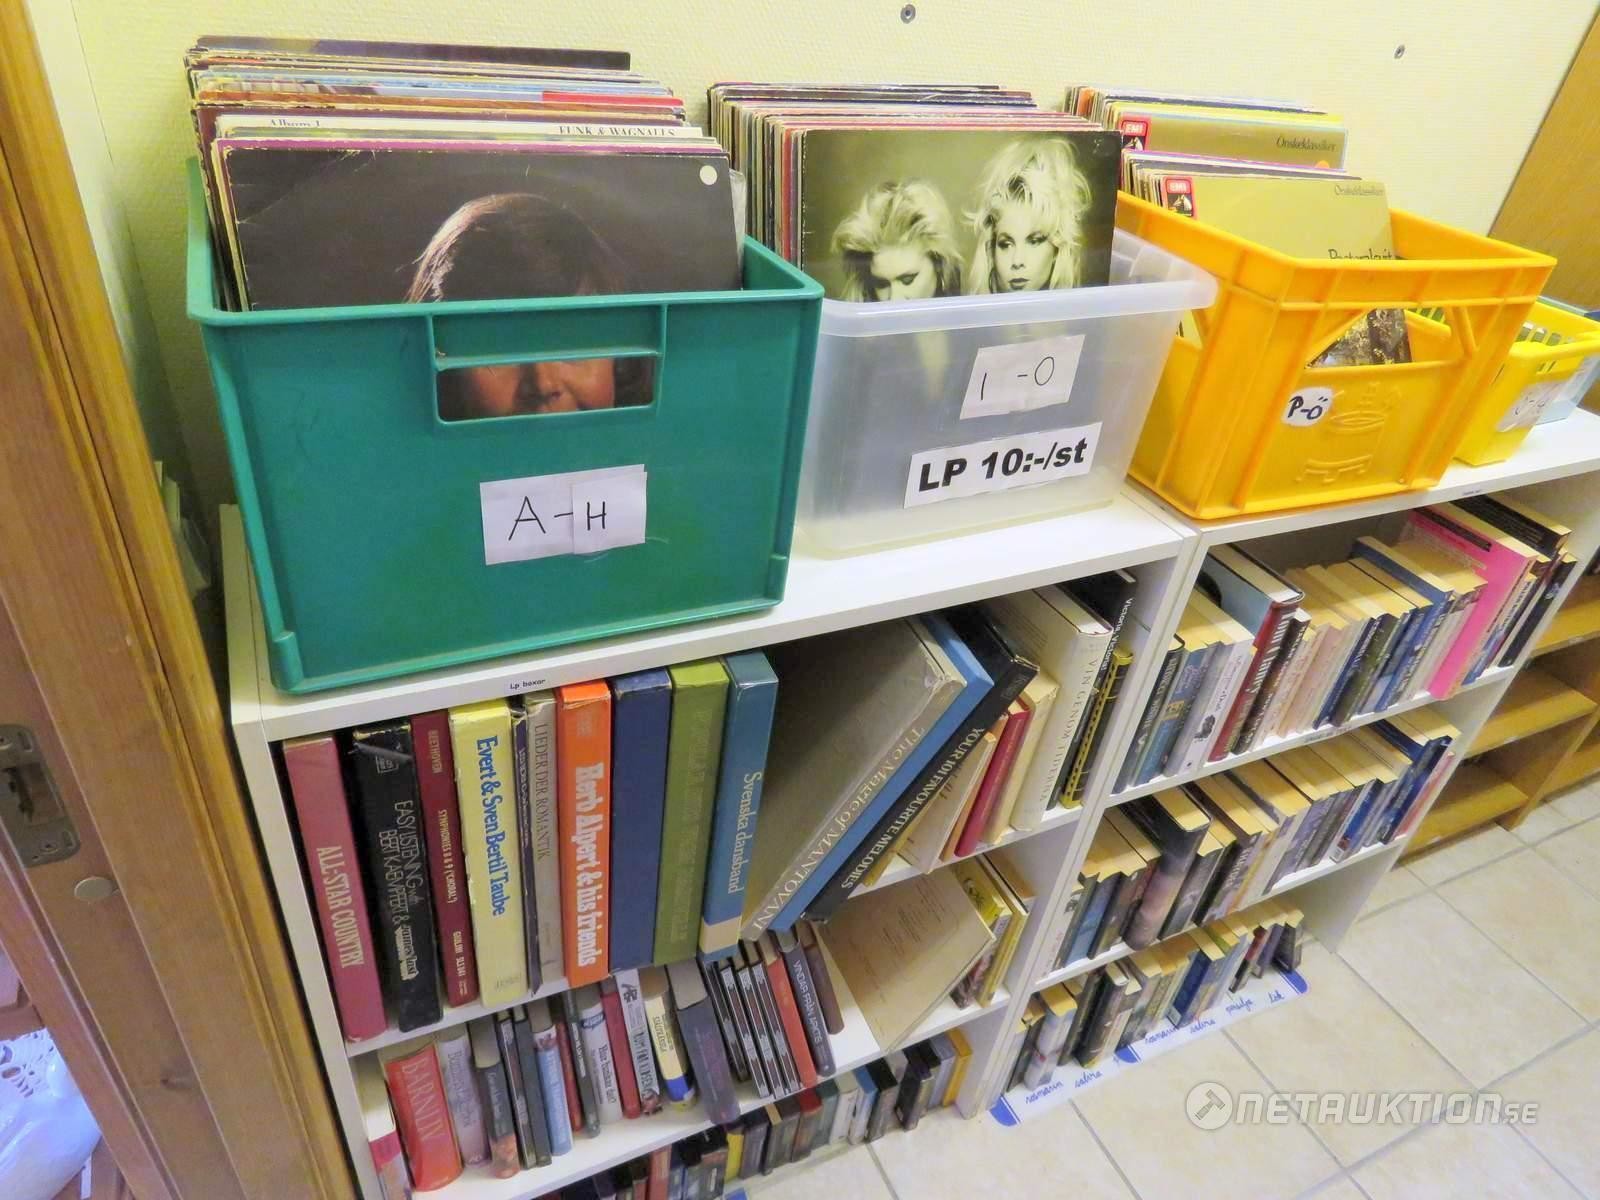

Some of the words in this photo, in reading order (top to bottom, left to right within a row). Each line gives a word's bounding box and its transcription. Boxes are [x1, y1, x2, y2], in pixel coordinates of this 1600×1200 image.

[559, 125, 593, 136] FUNK
[609, 126, 677, 137] WAGNALLS
[1124, 123, 1144, 134] EMI
[1169, 182, 1187, 192] EMI
[918, 458, 968, 493] LP
[981, 437, 1088, 480] 10:-/st
[1079, 660, 1097, 685] VIN
[475, 735, 498, 779] Evert
[533, 722, 548, 769] LIEDER
[893, 722, 925, 758] The
[950, 727, 985, 760] YOUR
[479, 779, 502, 796] &
[534, 770, 548, 796] DER
[574, 762, 603, 812] Herb
[845, 757, 895, 814] Magic
[935, 757, 956, 777] 101
[394, 800, 416, 829] EASY
[481, 794, 505, 832] Sven
[736, 771, 761, 830] Svenska
[831, 807, 854, 831] of
[885, 773, 943, 837] FAVOURITE
[379, 829, 400, 854] BERT
[436, 808, 451, 851] SYMPHONIES
[534, 797, 550, 860] ROMANTIK
[570, 813, 602, 870] Alpert
[398, 830, 423, 889] LISTENING
[485, 830, 508, 874] Bertil
[726, 831, 752, 893] dansband
[839, 831, 893, 890] MELODIES
[315, 844, 351, 910] ALL-STAR
[384, 855, 408, 913] KAEMPFERT
[489, 872, 511, 916] Taube
[576, 871, 603, 887] &
[750, 826, 840, 933] MANTOVANI
[576, 886, 602, 913] his
[329, 908, 363, 967] COUNTRY
[576, 911, 601, 967] friends
